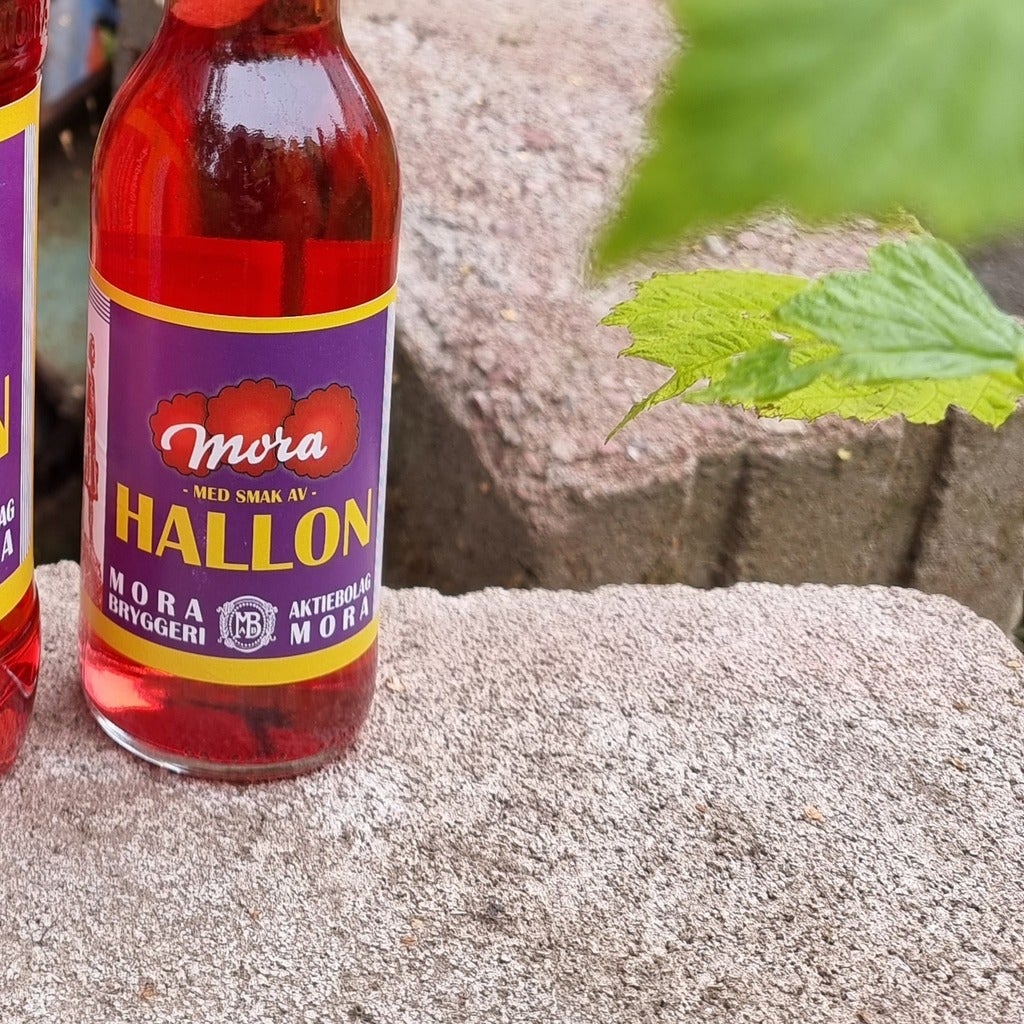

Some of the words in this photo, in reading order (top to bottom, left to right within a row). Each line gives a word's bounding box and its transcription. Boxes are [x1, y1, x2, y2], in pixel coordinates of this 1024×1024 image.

[193, 484, 231, 503] MED
[235, 487, 283, 504] SMAK
[286, 486, 309, 502] AV
[115, 482, 373, 573] HALLON
[108, 566, 204, 624] MORA
[288, 572, 372, 620] AKTIEBOLAG
[107, 597, 206, 646] BRYGGERI
[289, 596, 370, 647] MORA
